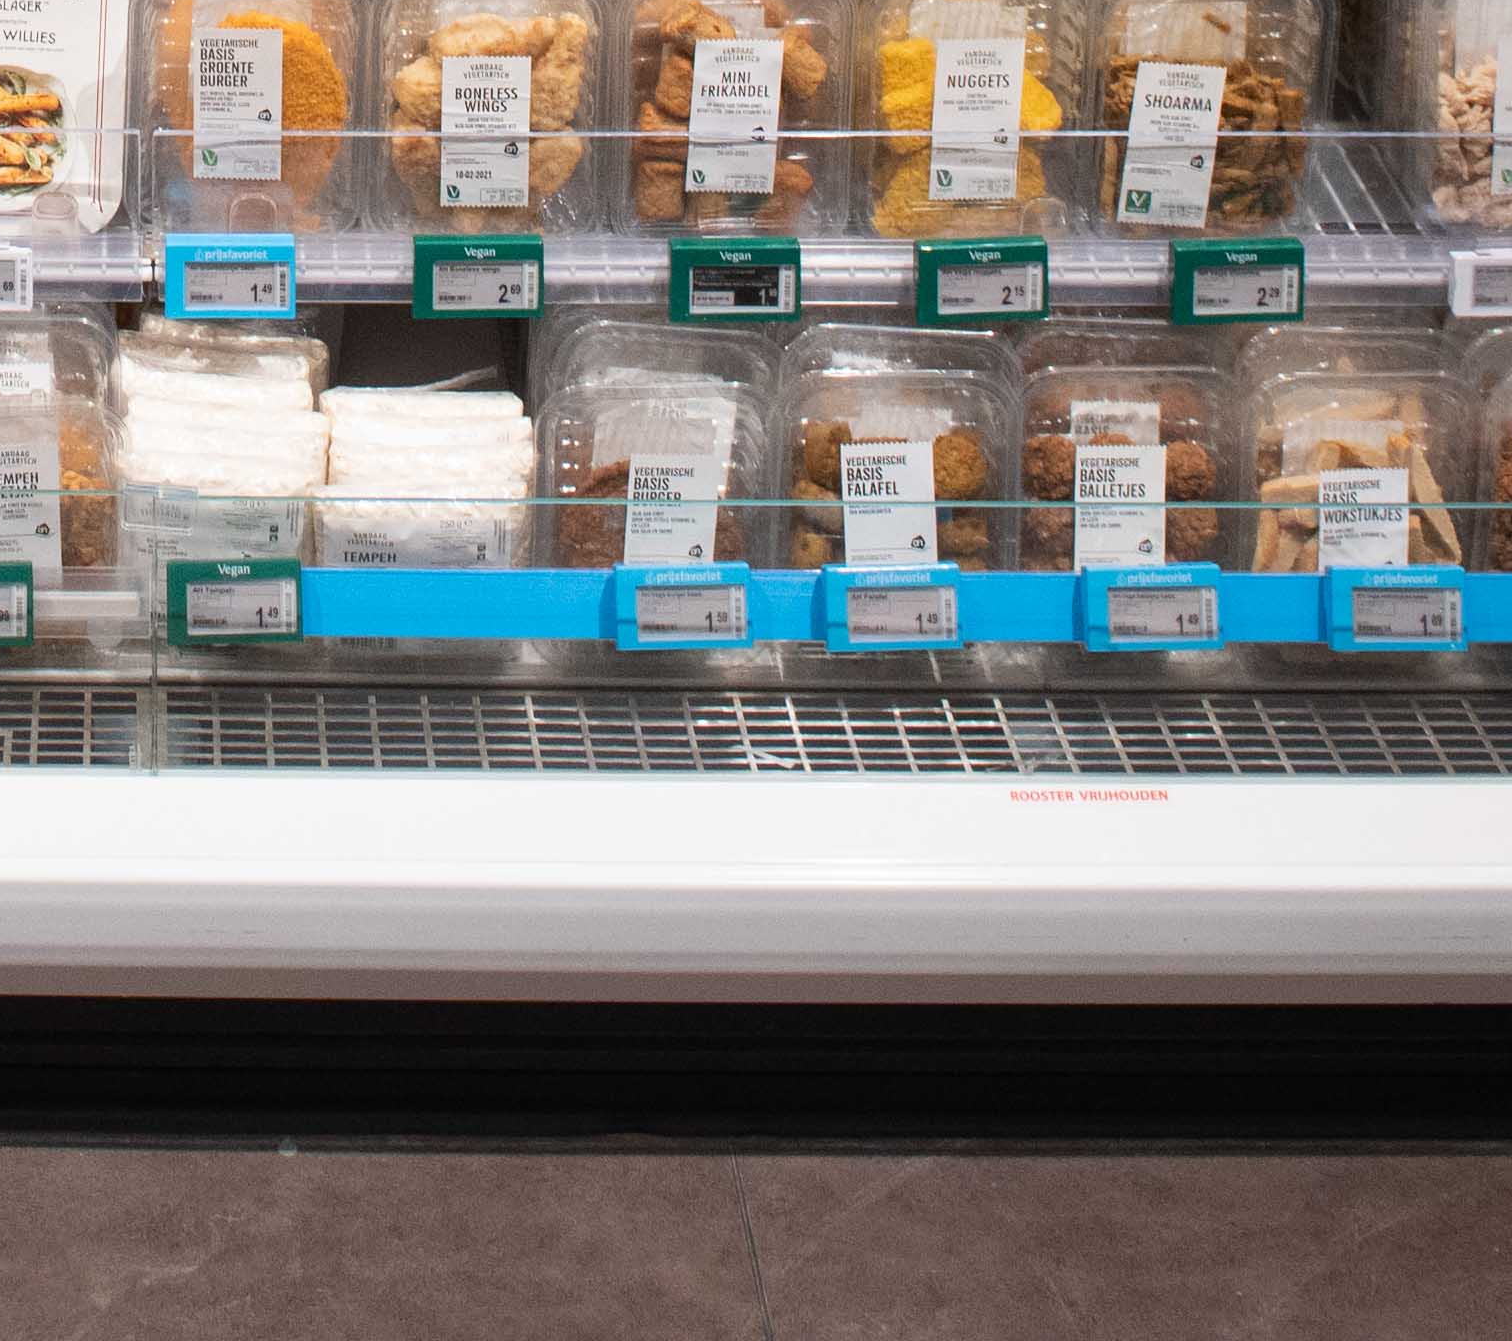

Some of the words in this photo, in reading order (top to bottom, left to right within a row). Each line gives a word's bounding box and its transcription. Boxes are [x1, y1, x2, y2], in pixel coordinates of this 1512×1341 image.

[3, 30, 57, 45] WILLIES
[199, 48, 235, 62] BASIS
[199, 61, 254, 76] GROENTE
[199, 74, 247, 89] BURGER
[722, 69, 751, 84] MINI
[947, 73, 1010, 90] NUGGETS
[455, 87, 518, 101] BONELESS
[700, 83, 770, 99] FRIKANDEL
[464, 99, 507, 114] WINGS
[1144, 93, 1212, 114] SHOARMA
[969, 250, 1001, 263] Vegan
[846, 455, 907, 467] VEGETARISCHE
[846, 467, 883, 481] BASIS
[846, 480, 899, 497] FALAFEL
[1078, 483, 1145, 499] BALLETJES
[1323, 506, 1402, 525] WOKSTUKJES
[1010, 790, 1074, 802] ROOSTER
[1079, 790, 1168, 801] VRIJHOUDEN
